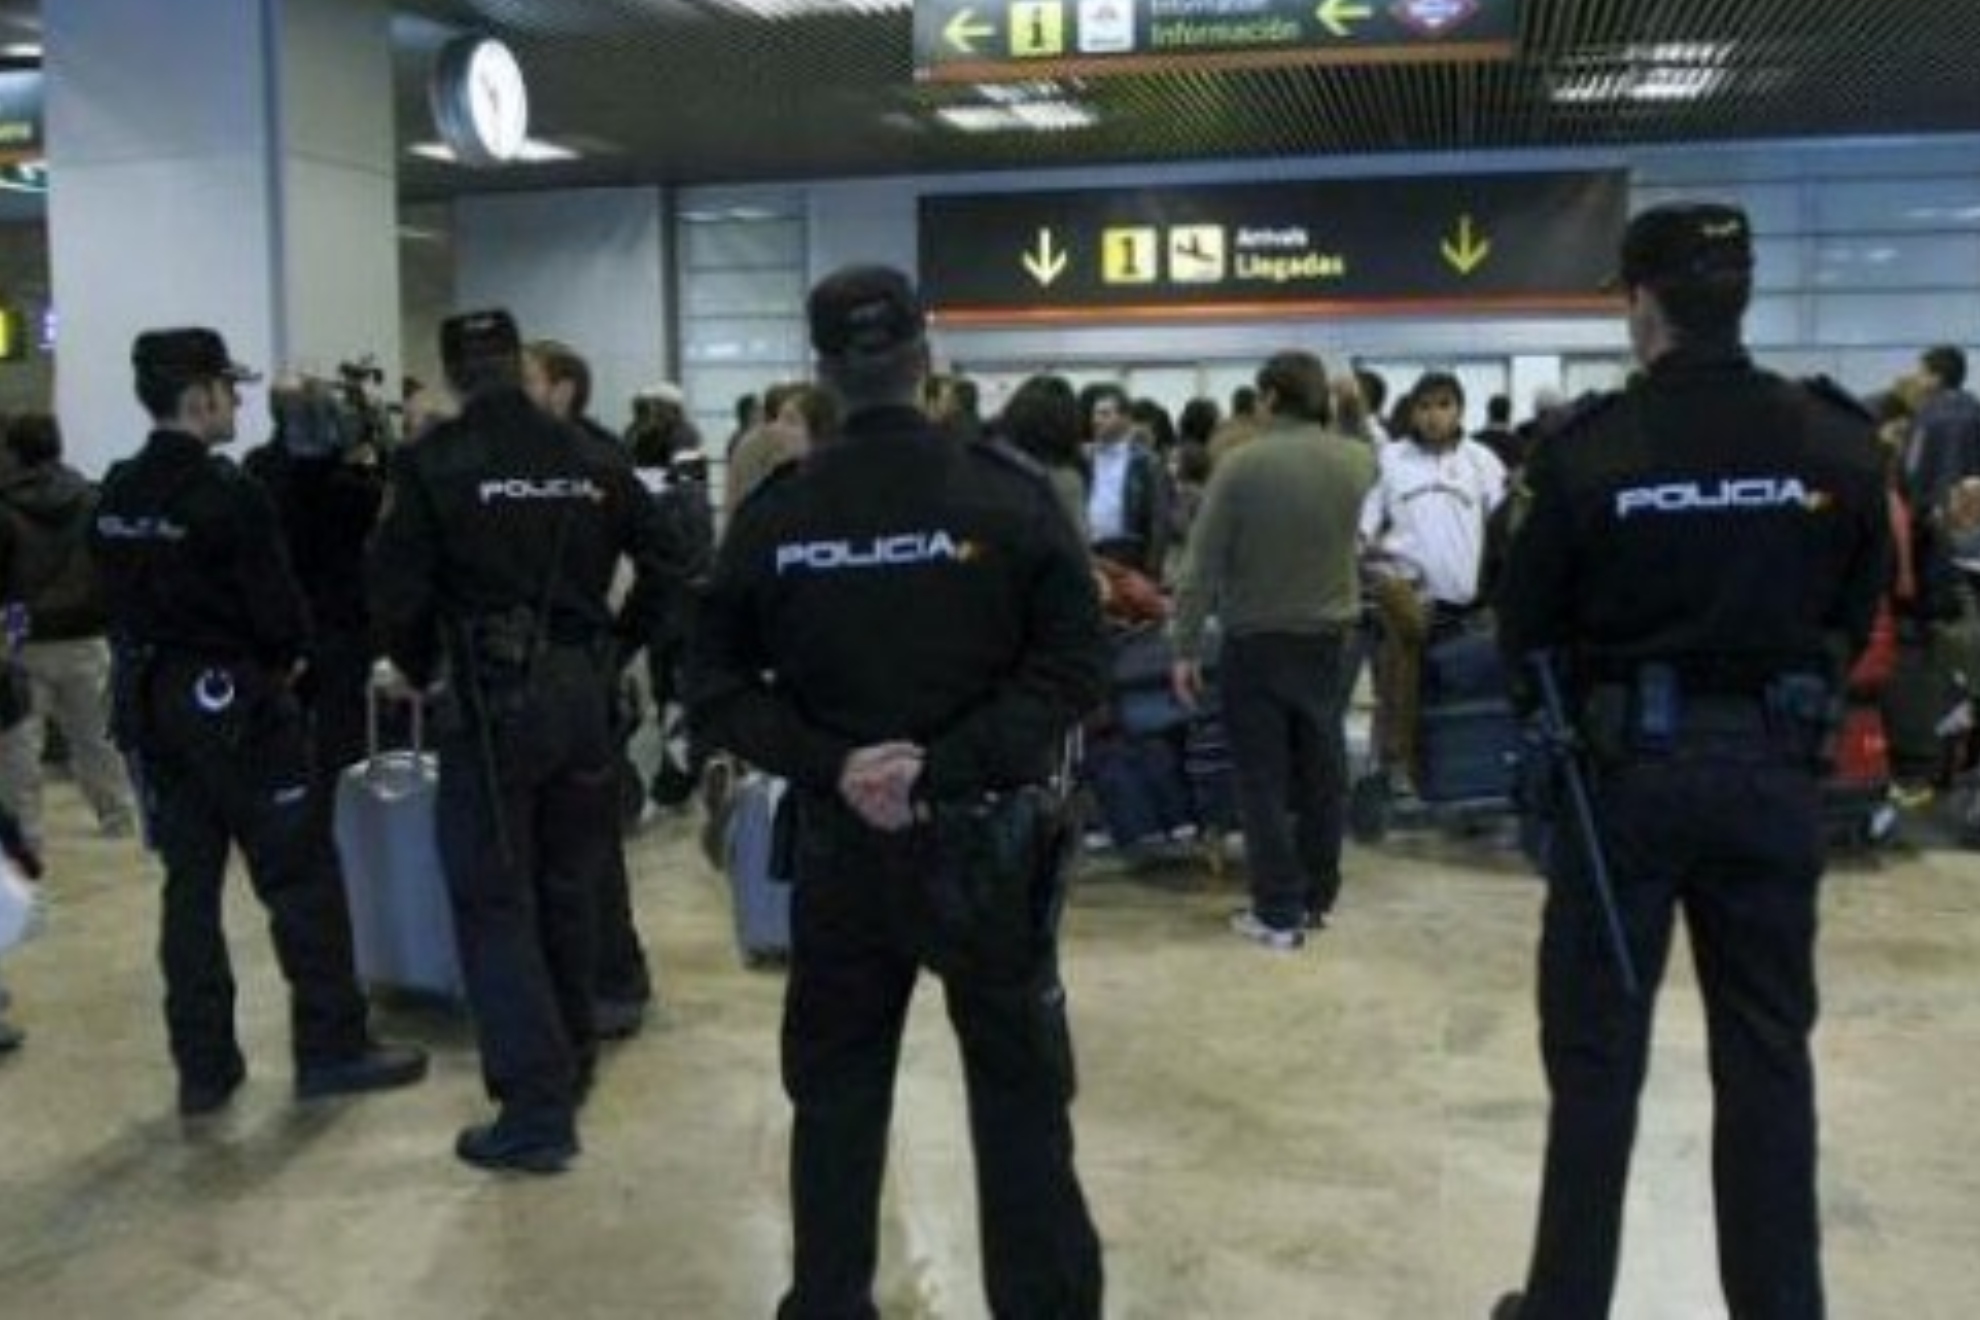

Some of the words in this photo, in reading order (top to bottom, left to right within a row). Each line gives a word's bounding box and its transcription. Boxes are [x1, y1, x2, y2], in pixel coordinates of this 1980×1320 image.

[1151, 19, 1299, 46] Información
[1235, 252, 1344, 282] Llegadas
[479, 478, 595, 504] POLICIA
[1616, 478, 1805, 519] POLICIA
[776, 529, 954, 576] POLICIA
